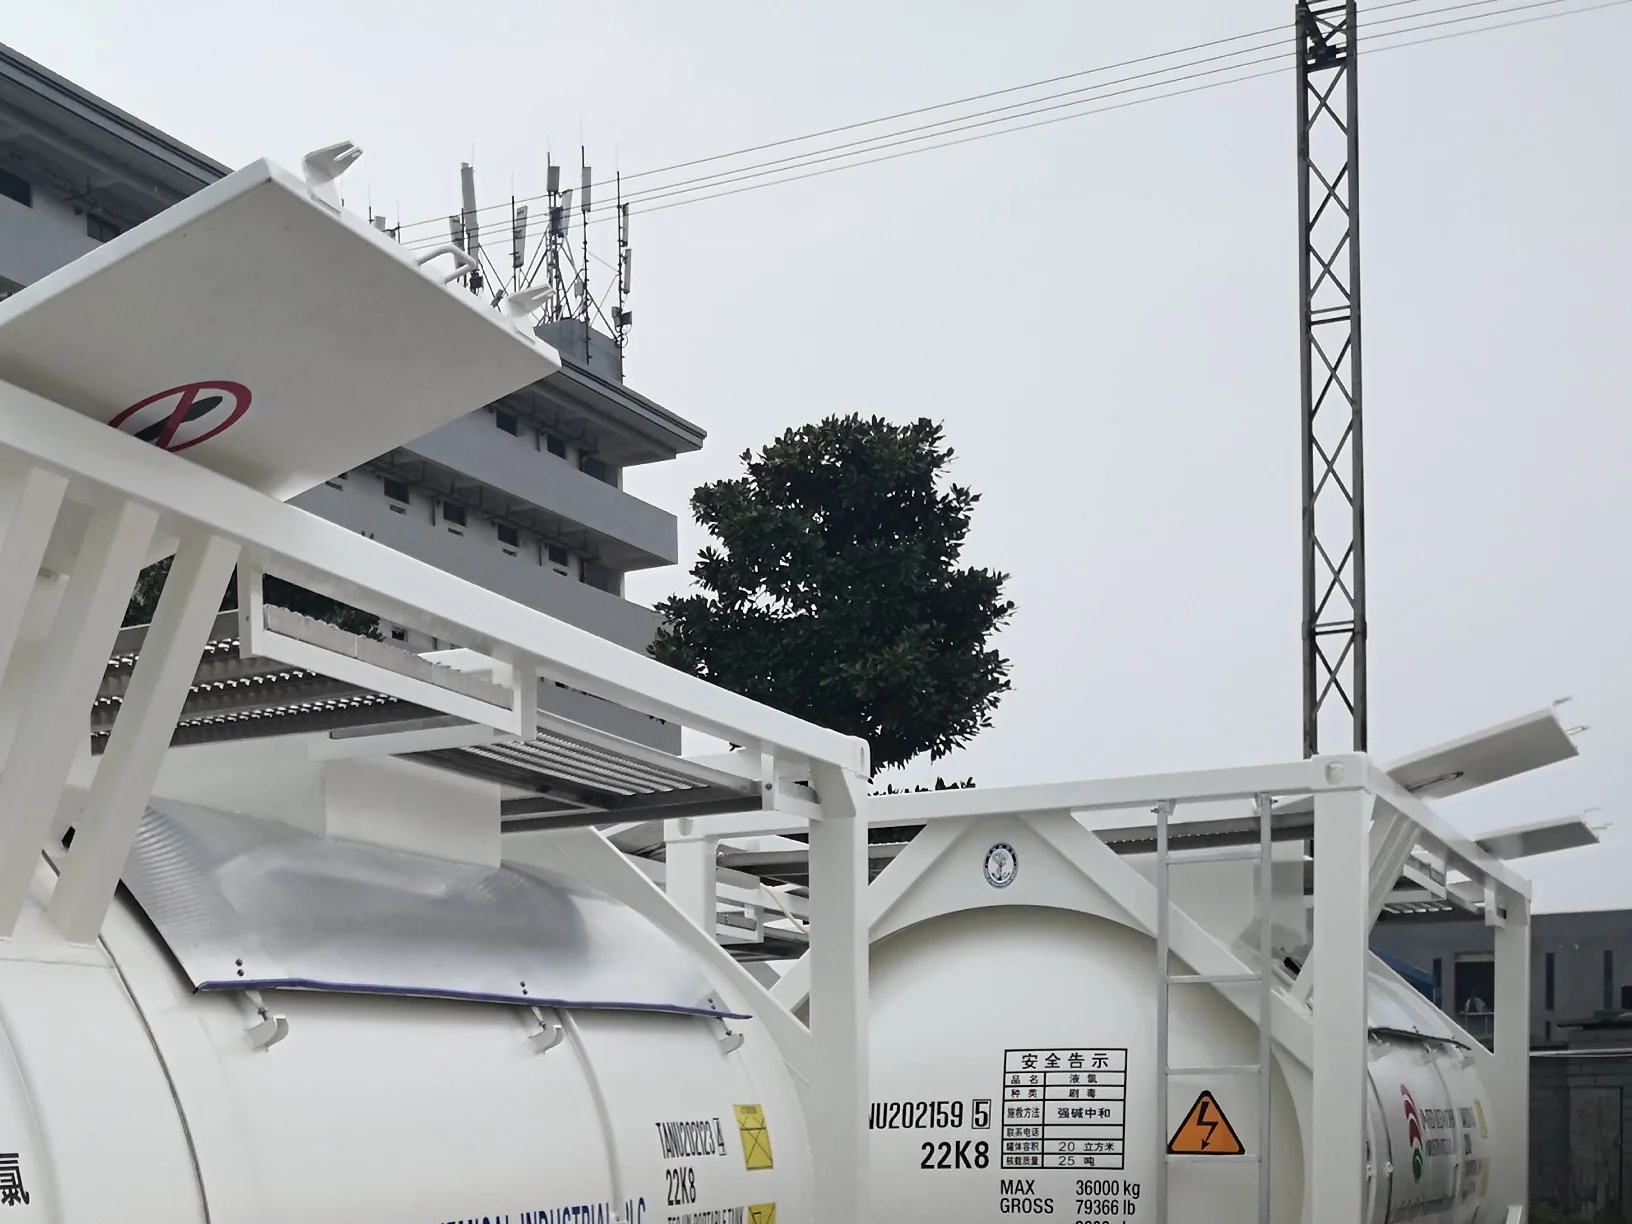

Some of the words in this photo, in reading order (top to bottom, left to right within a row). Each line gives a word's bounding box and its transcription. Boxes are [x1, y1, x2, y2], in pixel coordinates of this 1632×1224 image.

[1021, 1052, 1109, 1069] 安全告示
[1011, 1074, 1039, 1084] 品名
[973, 1101, 989, 1128] 5
[1057, 1107, 1111, 1119] 强碱中和
[921, 1141, 989, 1169] 22K8
[1058, 1142, 1075, 1152] 20
[1084, 1142, 1115, 1152] 立方米
[1058, 1155, 1075, 1166] 25
[666, 1167, 696, 1206] 22K8
[1001, 1180, 1035, 1195] MAX
[1076, 1180, 1119, 1196] 36000
[1123, 1180, 1140, 1199] kg
[1000, 1198, 1054, 1214] GROSS
[1076, 1200, 1119, 1216] 79366
[1123, 1200, 1135, 1216] lb
